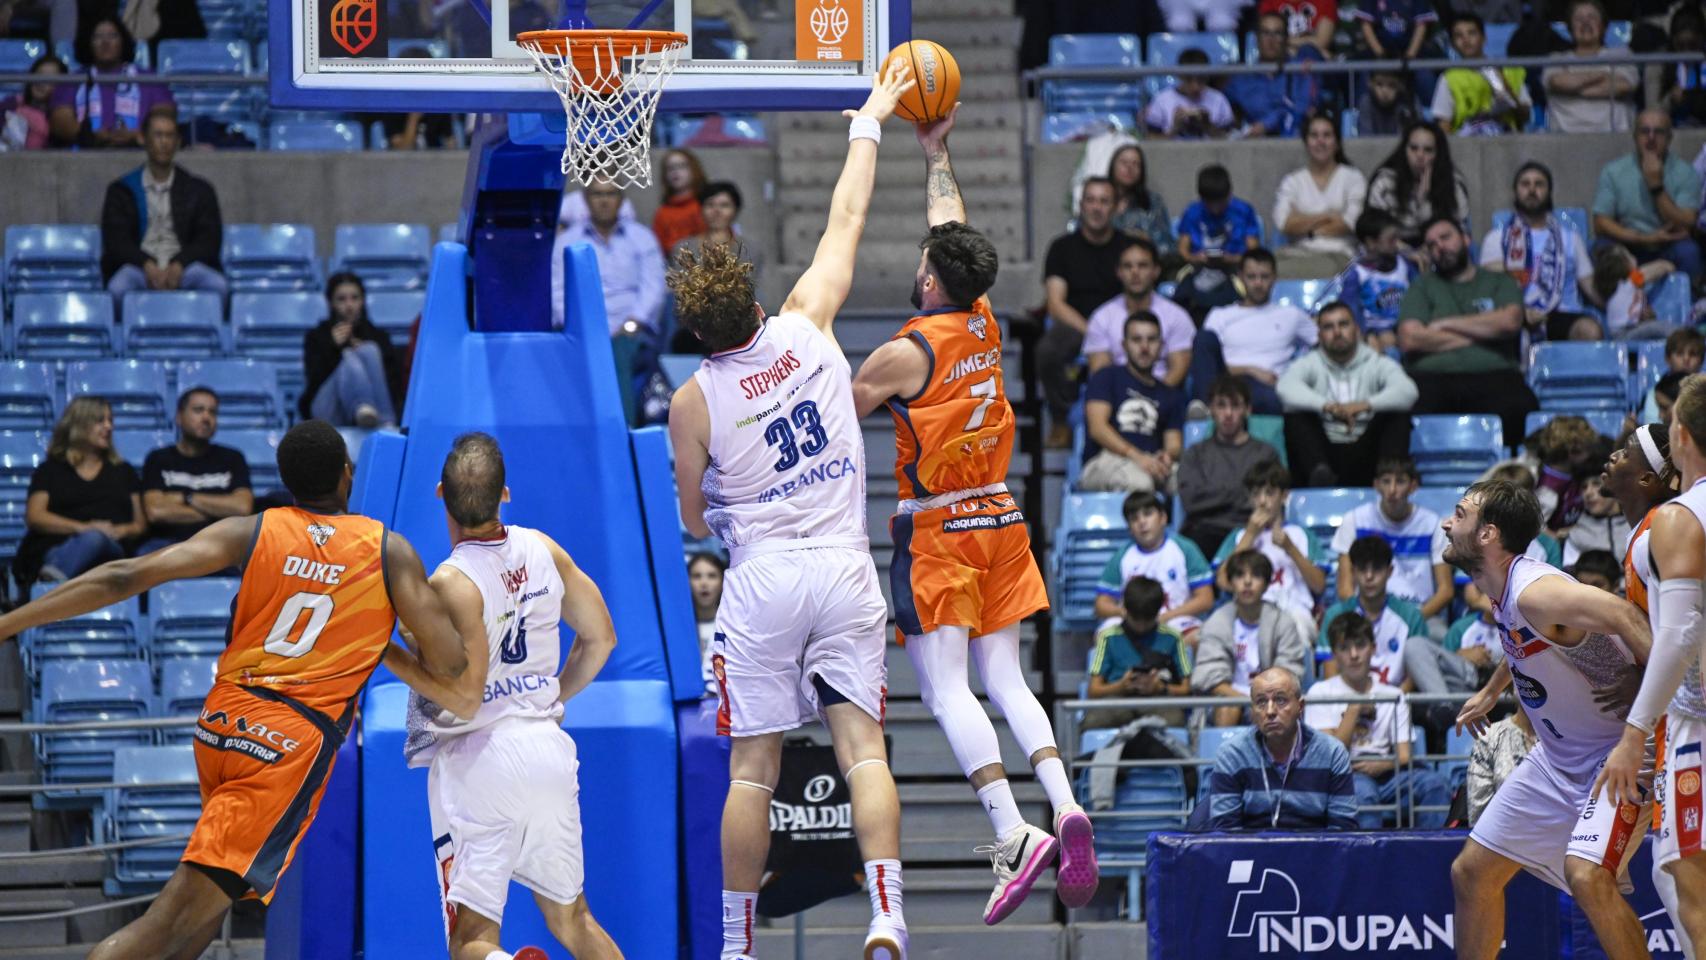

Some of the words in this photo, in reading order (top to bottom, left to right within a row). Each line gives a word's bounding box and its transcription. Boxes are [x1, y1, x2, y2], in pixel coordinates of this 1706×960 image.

[817, 51, 842, 59] FEB
[740, 350, 801, 400] STEPHENS
[736, 401, 782, 429] indupanel
[963, 374, 998, 432] 7
[764, 400, 829, 473] 33
[282, 555, 346, 585] DUKE
[264, 591, 336, 658] 0
[483, 675, 549, 703] BANCA
[1258, 913, 1506, 952] INDUPAN
